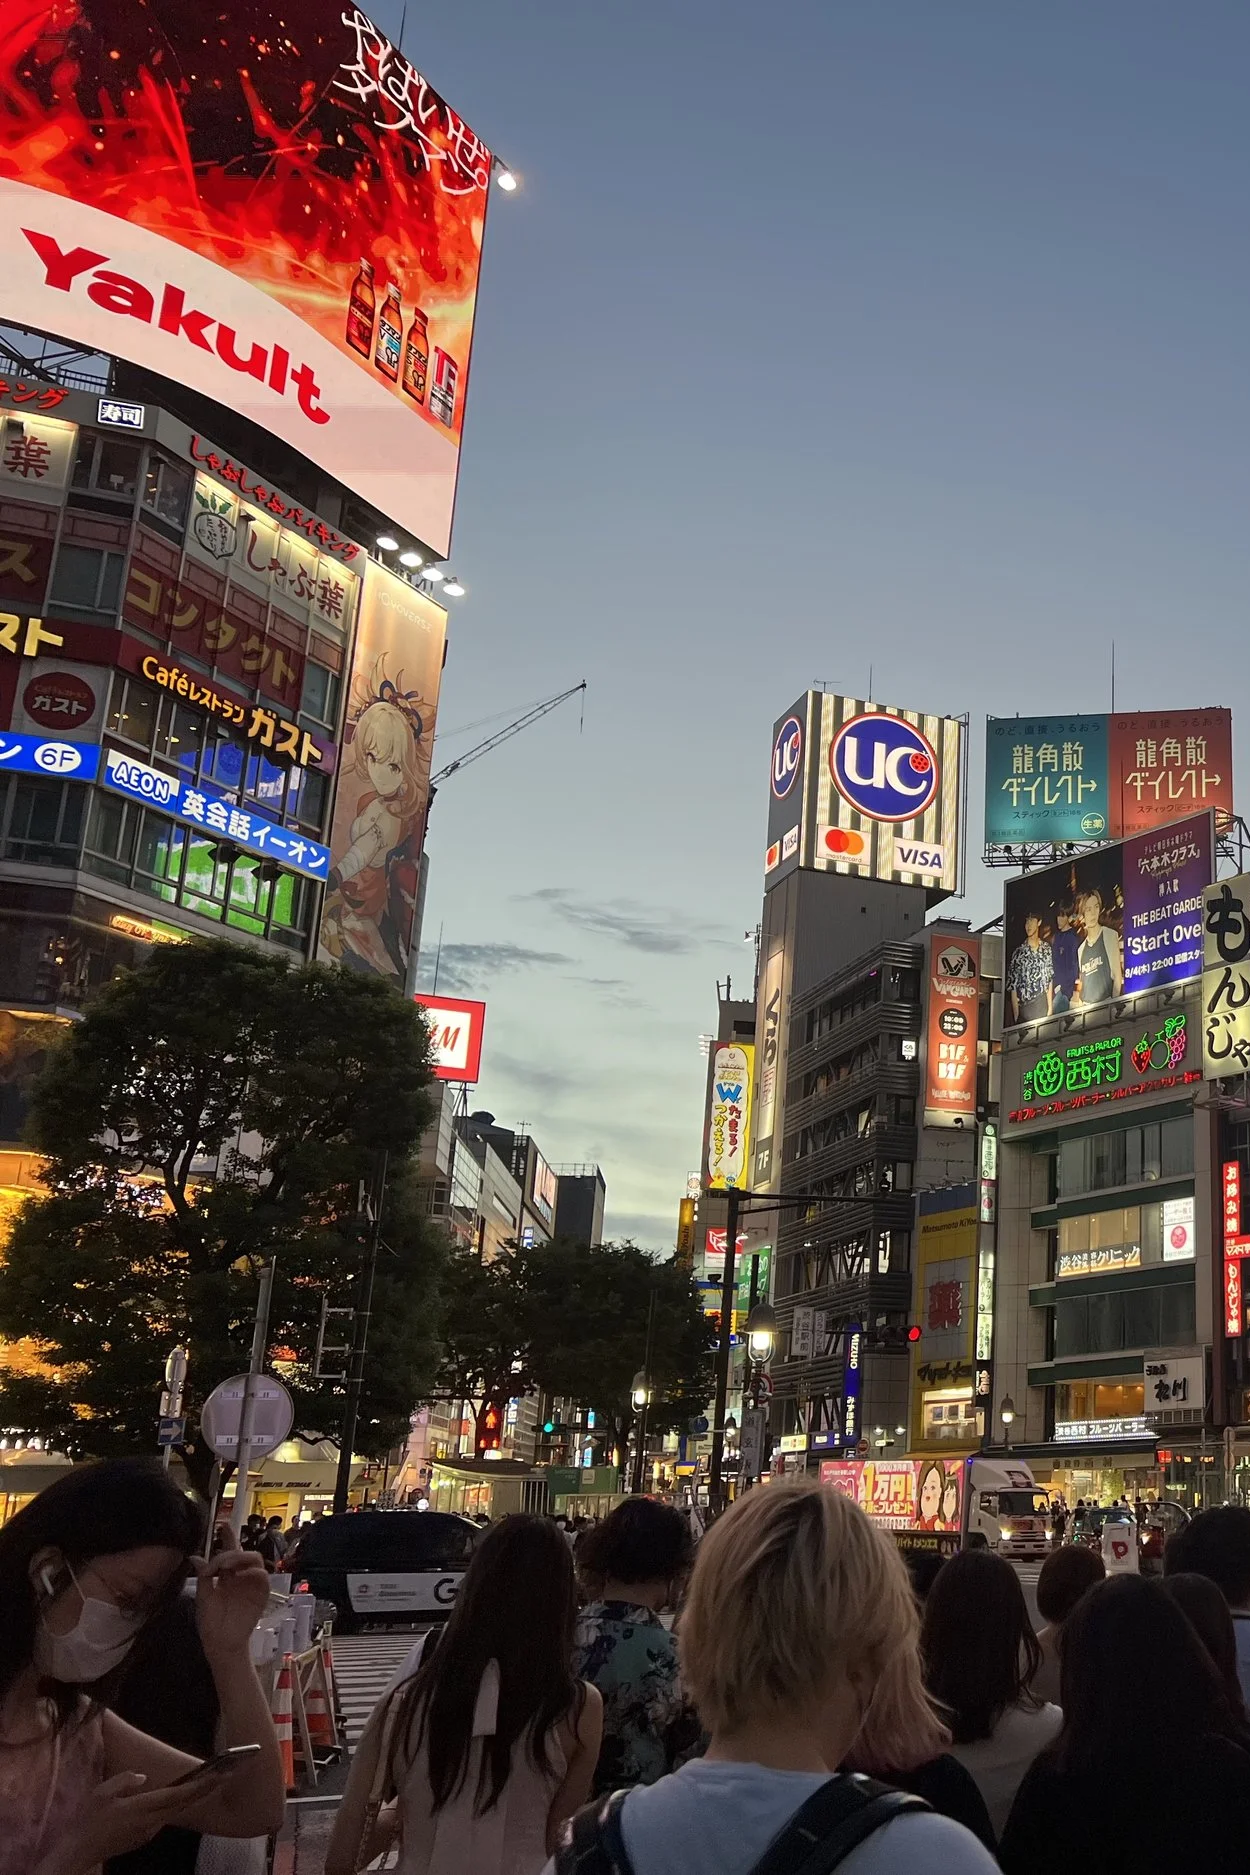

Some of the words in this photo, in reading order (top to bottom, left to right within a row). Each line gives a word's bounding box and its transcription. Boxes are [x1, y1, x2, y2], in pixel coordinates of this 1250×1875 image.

[20, 228, 331, 424] Yakult
[101, 404, 141, 425] 寿司
[4, 436, 51, 478] 葉
[190, 434, 361, 563] しゃぶしゃぶバイキング
[247, 528, 345, 620] しゃぶ葉
[125, 565, 295, 690] コンタクト
[32, 695, 87, 715] ガスト
[247, 706, 323, 767] ガスト
[1135, 736, 1207, 768] 龍角散
[41, 748, 76, 768] 6F
[1012, 741, 1084, 774] 龍角散
[112, 761, 170, 802] AEON
[1002, 775, 1098, 807] ダイレクト
[1125, 769, 1222, 801] ダイレクト
[1012, 809, 1050, 820] スティック
[1136, 803, 1175, 815] スティック
[181, 789, 326, 869] 英会話イーオン
[825, 853, 862, 863] mastercard
[895, 846, 942, 869] VISA
[1132, 914, 1149, 929] THE
[1150, 906, 1172, 923] BEAT
[1173, 895, 1204, 916] GARDE
[1124, 964, 1150, 978] 8/4(木)
[1152, 957, 1173, 971] 22:00
[1023, 1071, 1033, 1101] 渋谷
[1066, 1050, 1122, 1091] 西村
[716, 1083, 743, 1104] W
[713, 1104, 728, 1167] つかえる！
[728, 1105, 742, 1157] たまる！
[758, 1149, 770, 1171] 7F
[1226, 1166, 1238, 1233] お好み焼
[922, 1222, 958, 1235] Matsumoto
[1227, 1263, 1239, 1333] もんじゃ焼
[849, 1334, 860, 1370] MIZUHO
